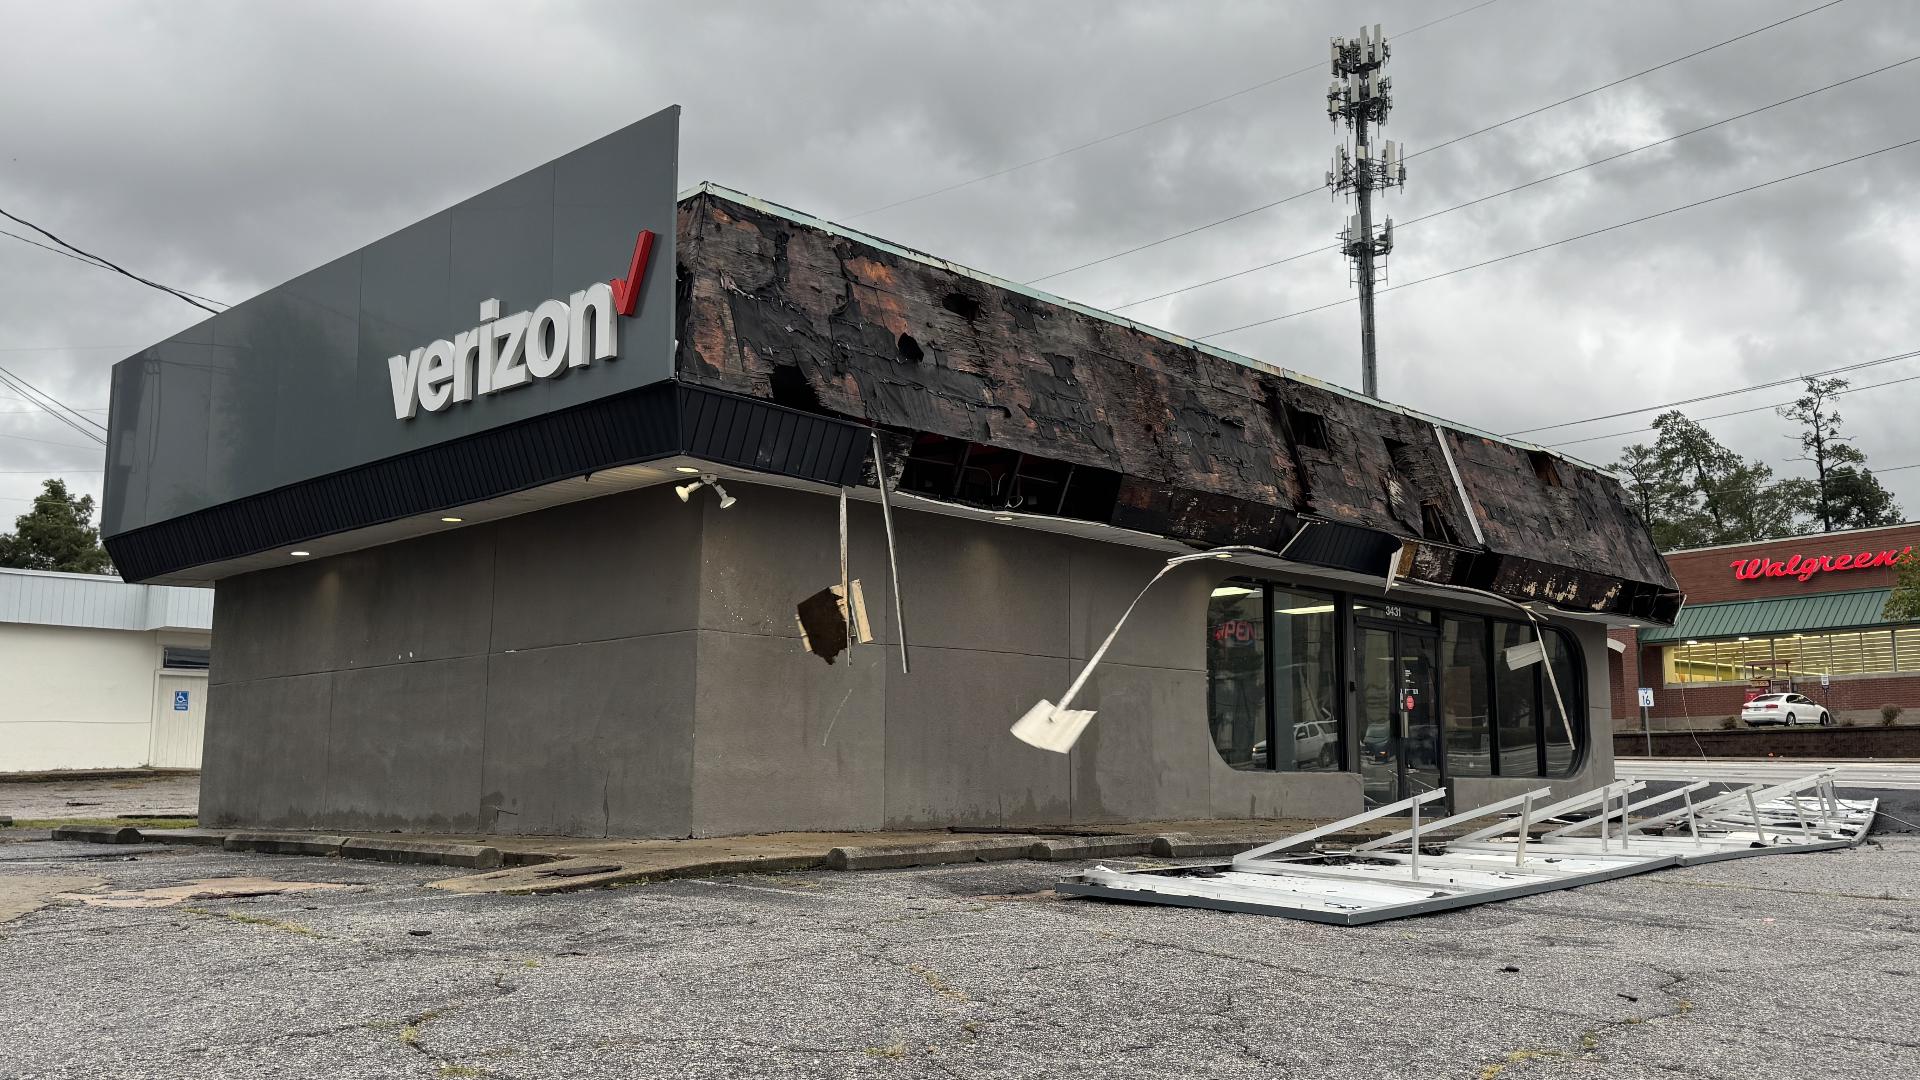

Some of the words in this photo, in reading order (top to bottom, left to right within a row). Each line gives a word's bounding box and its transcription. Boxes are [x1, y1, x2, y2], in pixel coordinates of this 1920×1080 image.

[388, 282, 618, 420] verizon
[1730, 546, 1912, 582] Walgreen
[1385, 605, 1401, 617] 3431
[1642, 695, 1651, 705] 16
